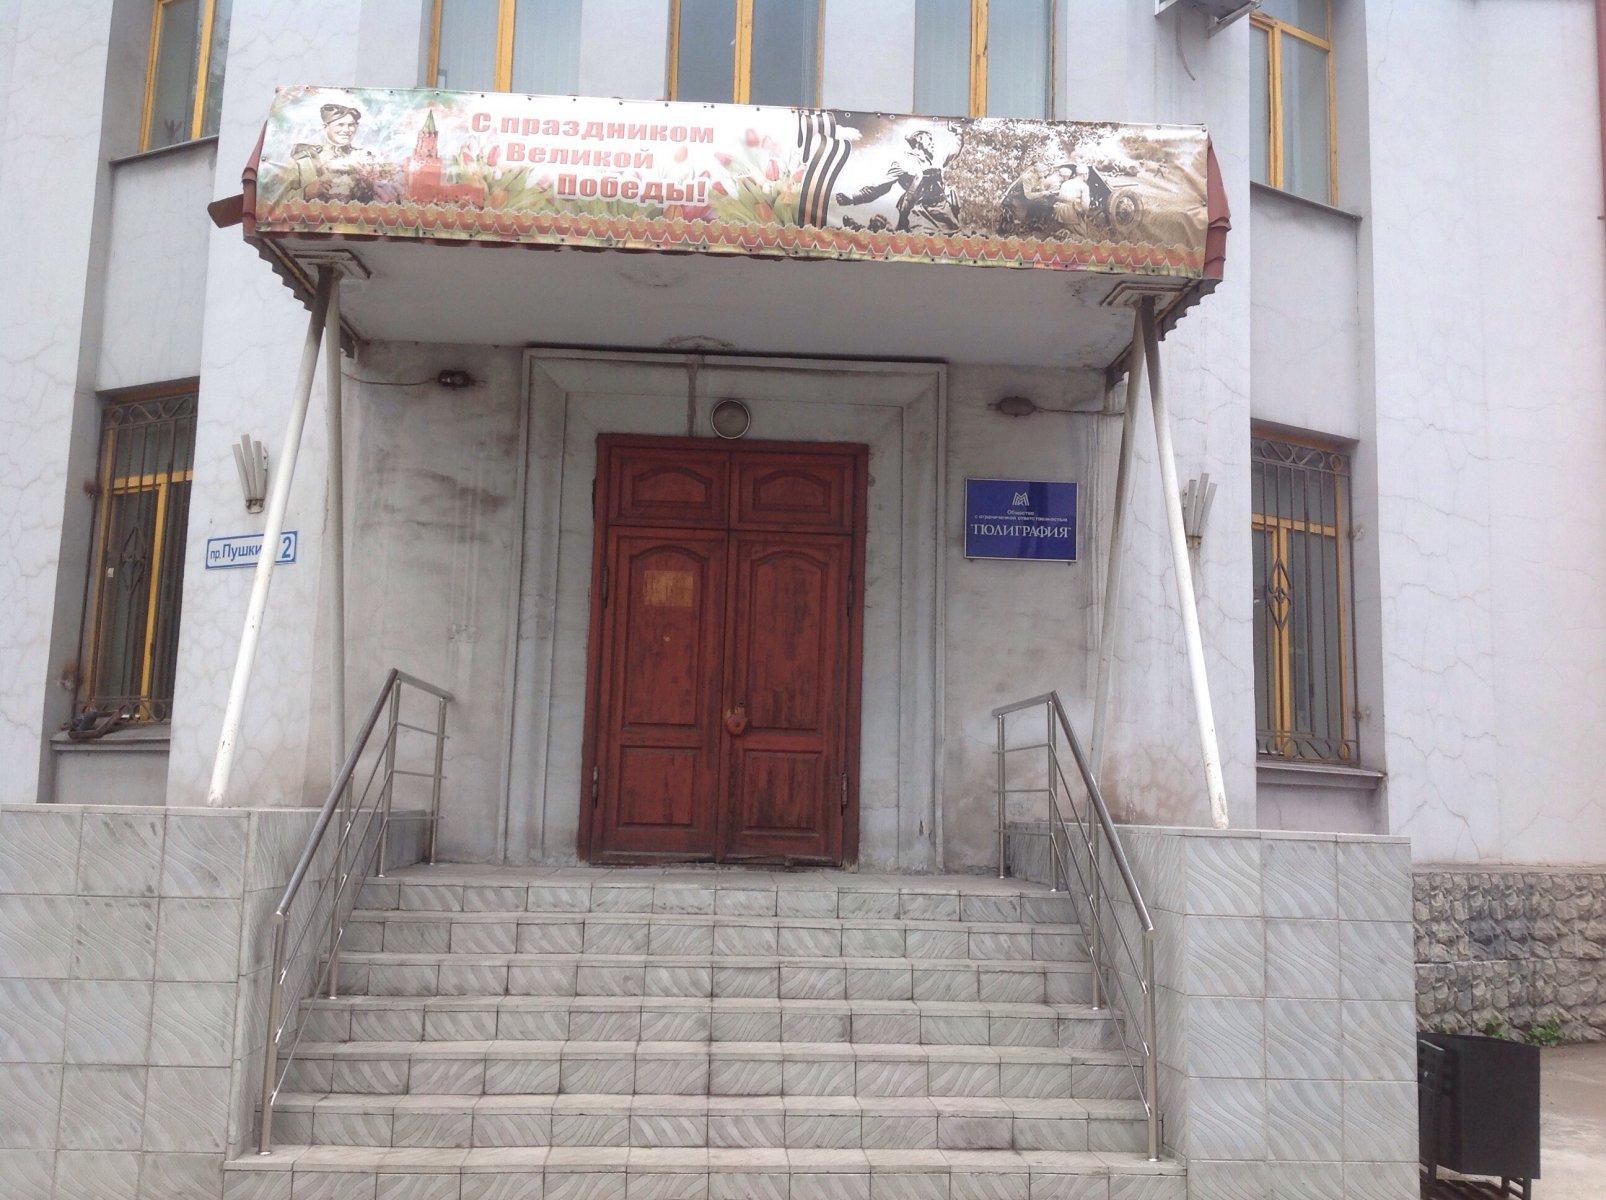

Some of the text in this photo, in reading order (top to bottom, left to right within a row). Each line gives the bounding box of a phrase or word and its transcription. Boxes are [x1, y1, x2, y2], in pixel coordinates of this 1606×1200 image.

[471, 112, 714, 144] С праздником
[506, 142, 654, 169] Великой
[557, 173, 707, 203] Победы!
[281, 536, 292, 559] 2
